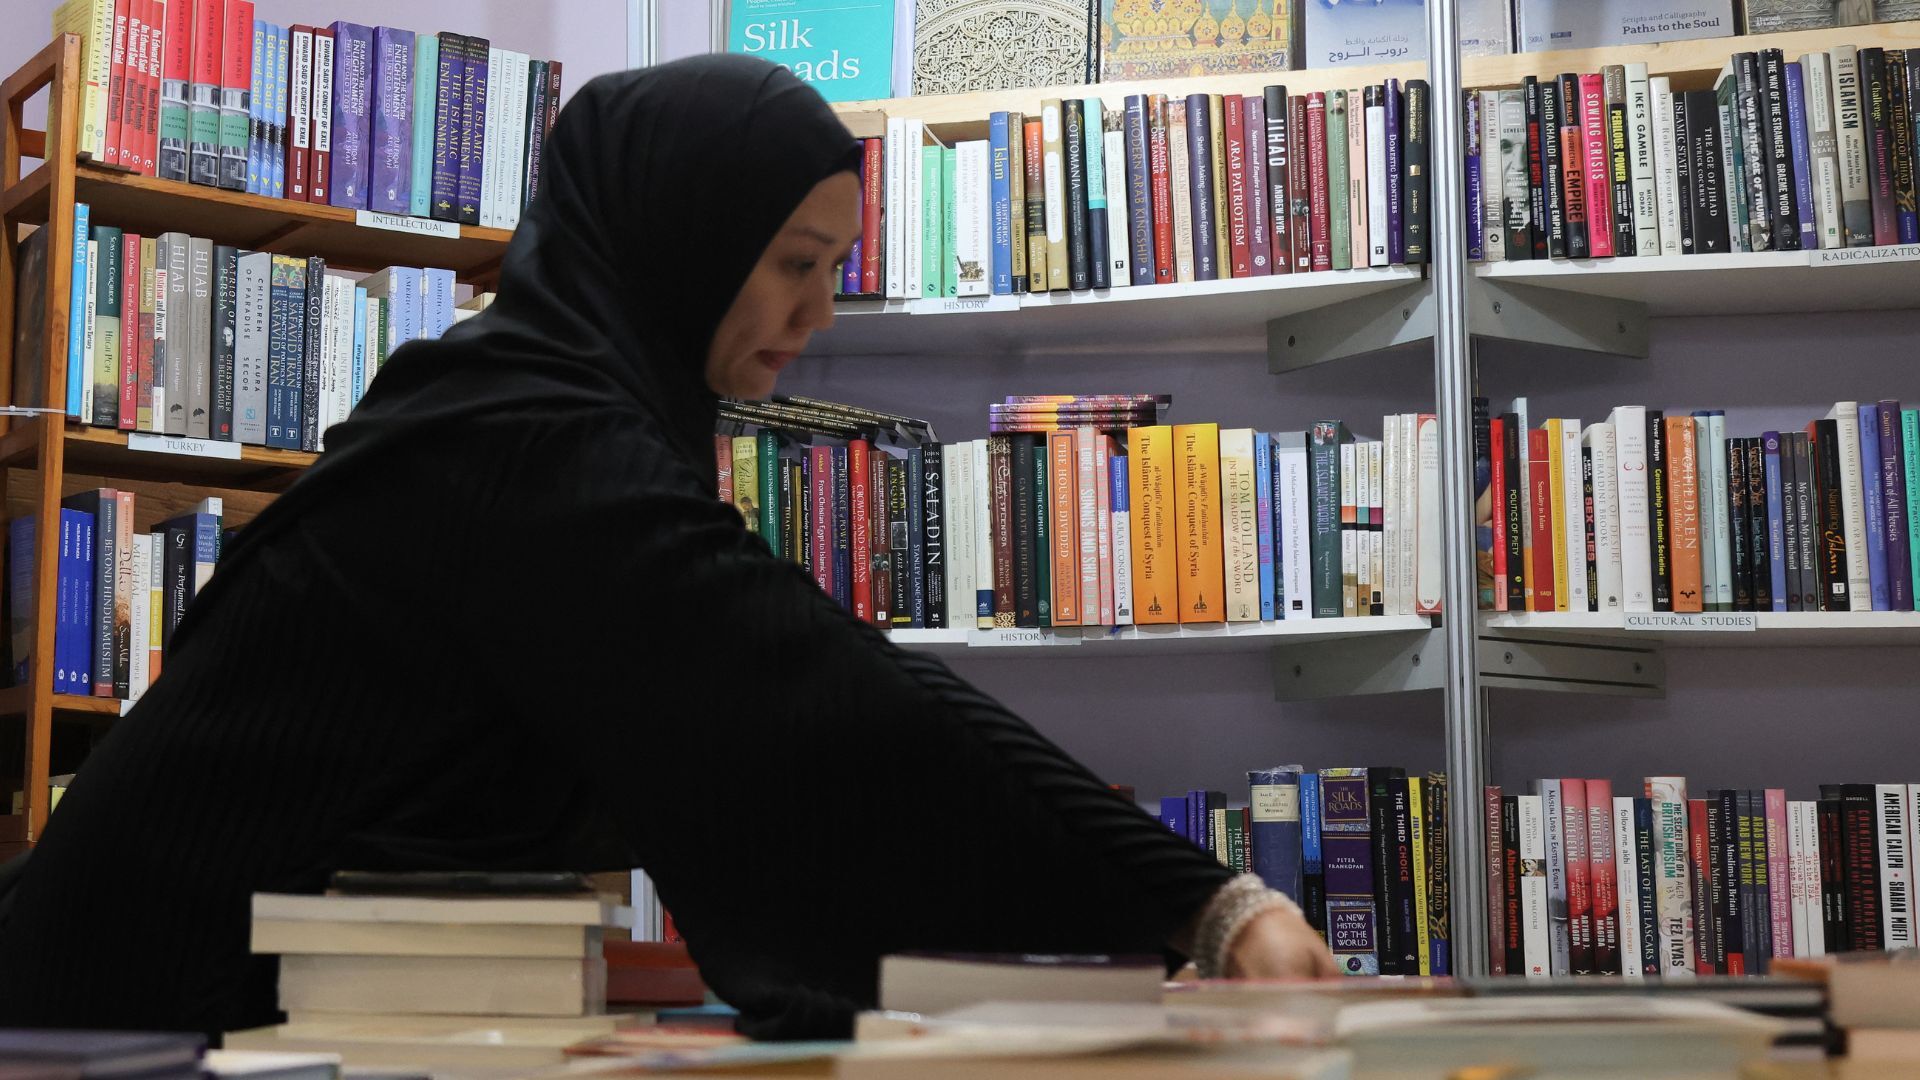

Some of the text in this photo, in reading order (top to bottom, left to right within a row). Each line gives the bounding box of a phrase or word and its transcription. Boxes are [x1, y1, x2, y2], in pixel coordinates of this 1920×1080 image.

[116, 25, 126, 49] Edward
[744, 19, 814, 52] Silk
[1623, 18, 1719, 35] Paths to the Soul
[1665, 10, 1706, 20] Calligraphy
[114, 50, 124, 64] Said
[253, 31, 264, 105] Edward Said
[778, 50, 860, 81] ads
[1375, 47, 1408, 58] دروب
[300, 117, 306, 125] OF
[436, 62, 449, 166] ENLIGHTENMENT
[449, 74, 461, 159] THE ISLAMIC
[1838, 72, 1859, 129] ISLAMISM
[1871, 81, 1882, 121] Challenge
[1267, 118, 1286, 167] JIHAD
[1586, 93, 1604, 180] SOWING CRISIS
[1611, 110, 1626, 182] PERILOUS POWER
[1635, 92, 1648, 168] IKE'S GAMBLE
[1674, 102, 1688, 177] ISLAMIC STATE
[1767, 60, 1789, 216] THE WAY OF THE STRANGERS GRAEME WOOD
[994, 147, 1007, 180] Islam
[1068, 123, 1080, 190] OTTOMANIA
[1543, 88, 1561, 240] RASHID KHALIDI Resurrecting EMPIRE
[1704, 127, 1717, 217] THE AGE OF JIHAD
[1746, 97, 1766, 228] WAR IN THE AGE OF TRUMP
[1131, 117, 1148, 263] MODERN ARAB KINGSHIP
[1230, 140, 1245, 246] ARAB PATRIOTISM
[1274, 184, 1285, 235] ANDREW HYDE
[1566, 170, 1583, 220] EMPIRE
[75, 216, 88, 265] TURKEY
[372, 215, 444, 232] INTELLECTUAL
[171, 245, 185, 293] HIJAB
[194, 250, 208, 298] HIJAB
[1822, 247, 1920, 261] RADICALIZATIO
[256, 278, 264, 333] CHILDREN
[310, 297, 320, 326] GOD
[944, 301, 986, 311] HISTORY
[270, 299, 280, 385] SAFAVID IRAN
[254, 358, 262, 392] LAURA
[165, 440, 205, 453] TURKEY
[1140, 436, 1151, 454] The
[1058, 441, 1069, 558] THE HOUSE DIVIDED
[1654, 468, 1662, 508] Censorship
[856, 484, 866, 582] CROWDS AND SULTANS
[925, 472, 941, 565] SALADIN
[1140, 494, 1153, 538] Conquest
[1239, 470, 1254, 583] TOM HOLLAND
[1510, 489, 1519, 556] POLITICS OF PIETY
[1657, 509, 1662, 517] in
[1783, 482, 1797, 570] My Cousin, My Husband
[104, 539, 113, 583] BEYOND
[1142, 554, 1155, 580] Syria
[1144, 539, 1153, 551] of
[103, 587, 112, 623] HINDU
[1628, 616, 1752, 626] CULTURAL STUDIES
[101, 631, 112, 677] MUSLIM
[1000, 632, 1047, 641] HISTORY
[1328, 801, 1362, 814] ROADS
[1332, 791, 1357, 802] SILK
[1673, 803, 1682, 815] THE
[1395, 793, 1408, 882] THE THIRD CHOICE
[1412, 816, 1420, 840] JIHAD
[1490, 793, 1500, 876] A FAITHFUL SEA
[1564, 806, 1578, 863] MADELEINE
[1662, 802, 1676, 878] BRITISH MUSLIM
[1674, 816, 1683, 842] SECRET
[1738, 816, 1752, 885] ARAB NEW YORK
[1675, 843, 1684, 862] DIARY
[1676, 864, 1684, 872] OF
[1883, 792, 1908, 941] AMERICAN CALIPH SHAHAN MUFTI
[1506, 848, 1518, 948] Albanian Identities
[1640, 829, 1655, 960] THE LAST OF THE LASCARS
[1726, 844, 1738, 916] Muslims in Britain
[1337, 922, 1366, 930] HISTORY
[1337, 930, 1367, 939] OF THE
[1346, 913, 1365, 921] NEW
[1670, 918, 1685, 967] TEZ ILYAS
